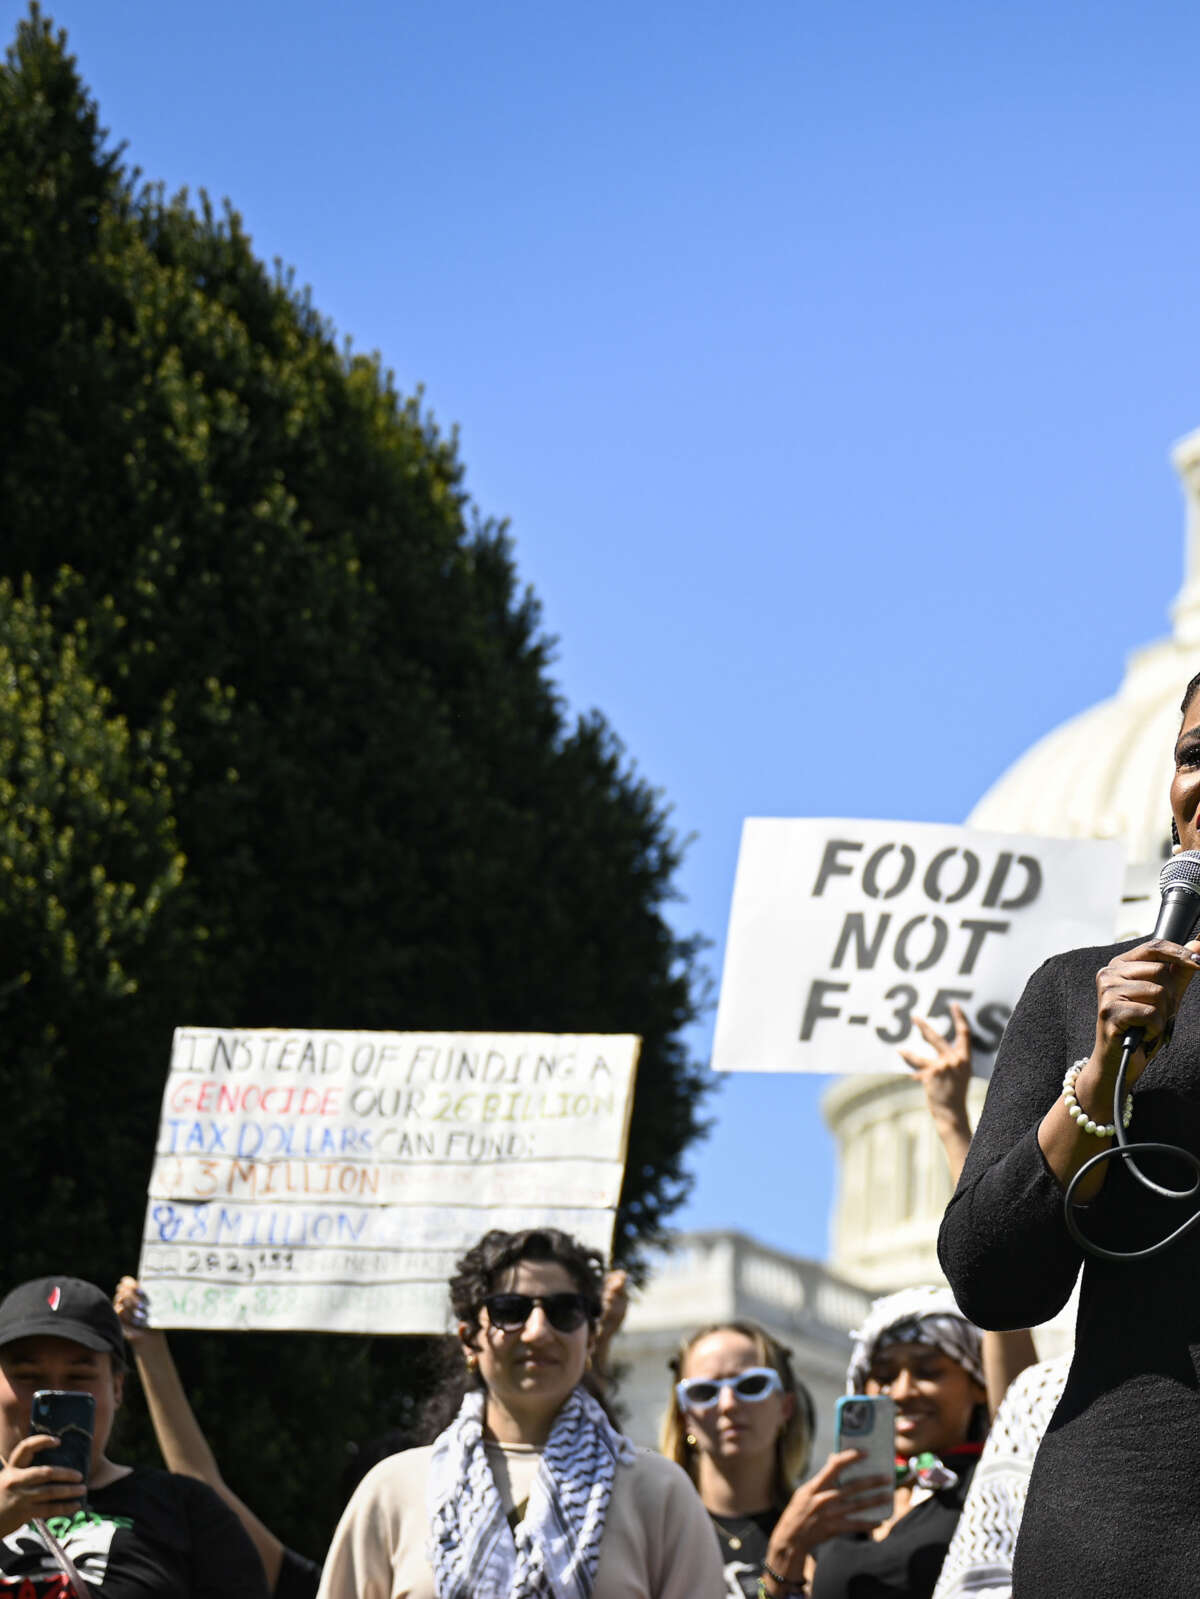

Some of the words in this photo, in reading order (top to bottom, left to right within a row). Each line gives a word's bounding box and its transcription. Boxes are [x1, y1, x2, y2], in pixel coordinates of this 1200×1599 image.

[812, 838, 1043, 911] FOOD
[831, 911, 1010, 976] NOT
[173, 1032, 344, 1075] INSTEAD
[350, 1040, 403, 1082] OF
[590, 1053, 613, 1080] A
[168, 1079, 345, 1117] GENOCIDE
[349, 1085, 427, 1118] OUR
[166, 1118, 229, 1153] TAX
[236, 1121, 374, 1158] DOLLARS
[376, 1127, 436, 1157] CAN
[226, 1157, 380, 1199] MILLION
[216, 1206, 369, 1245] MILLION
